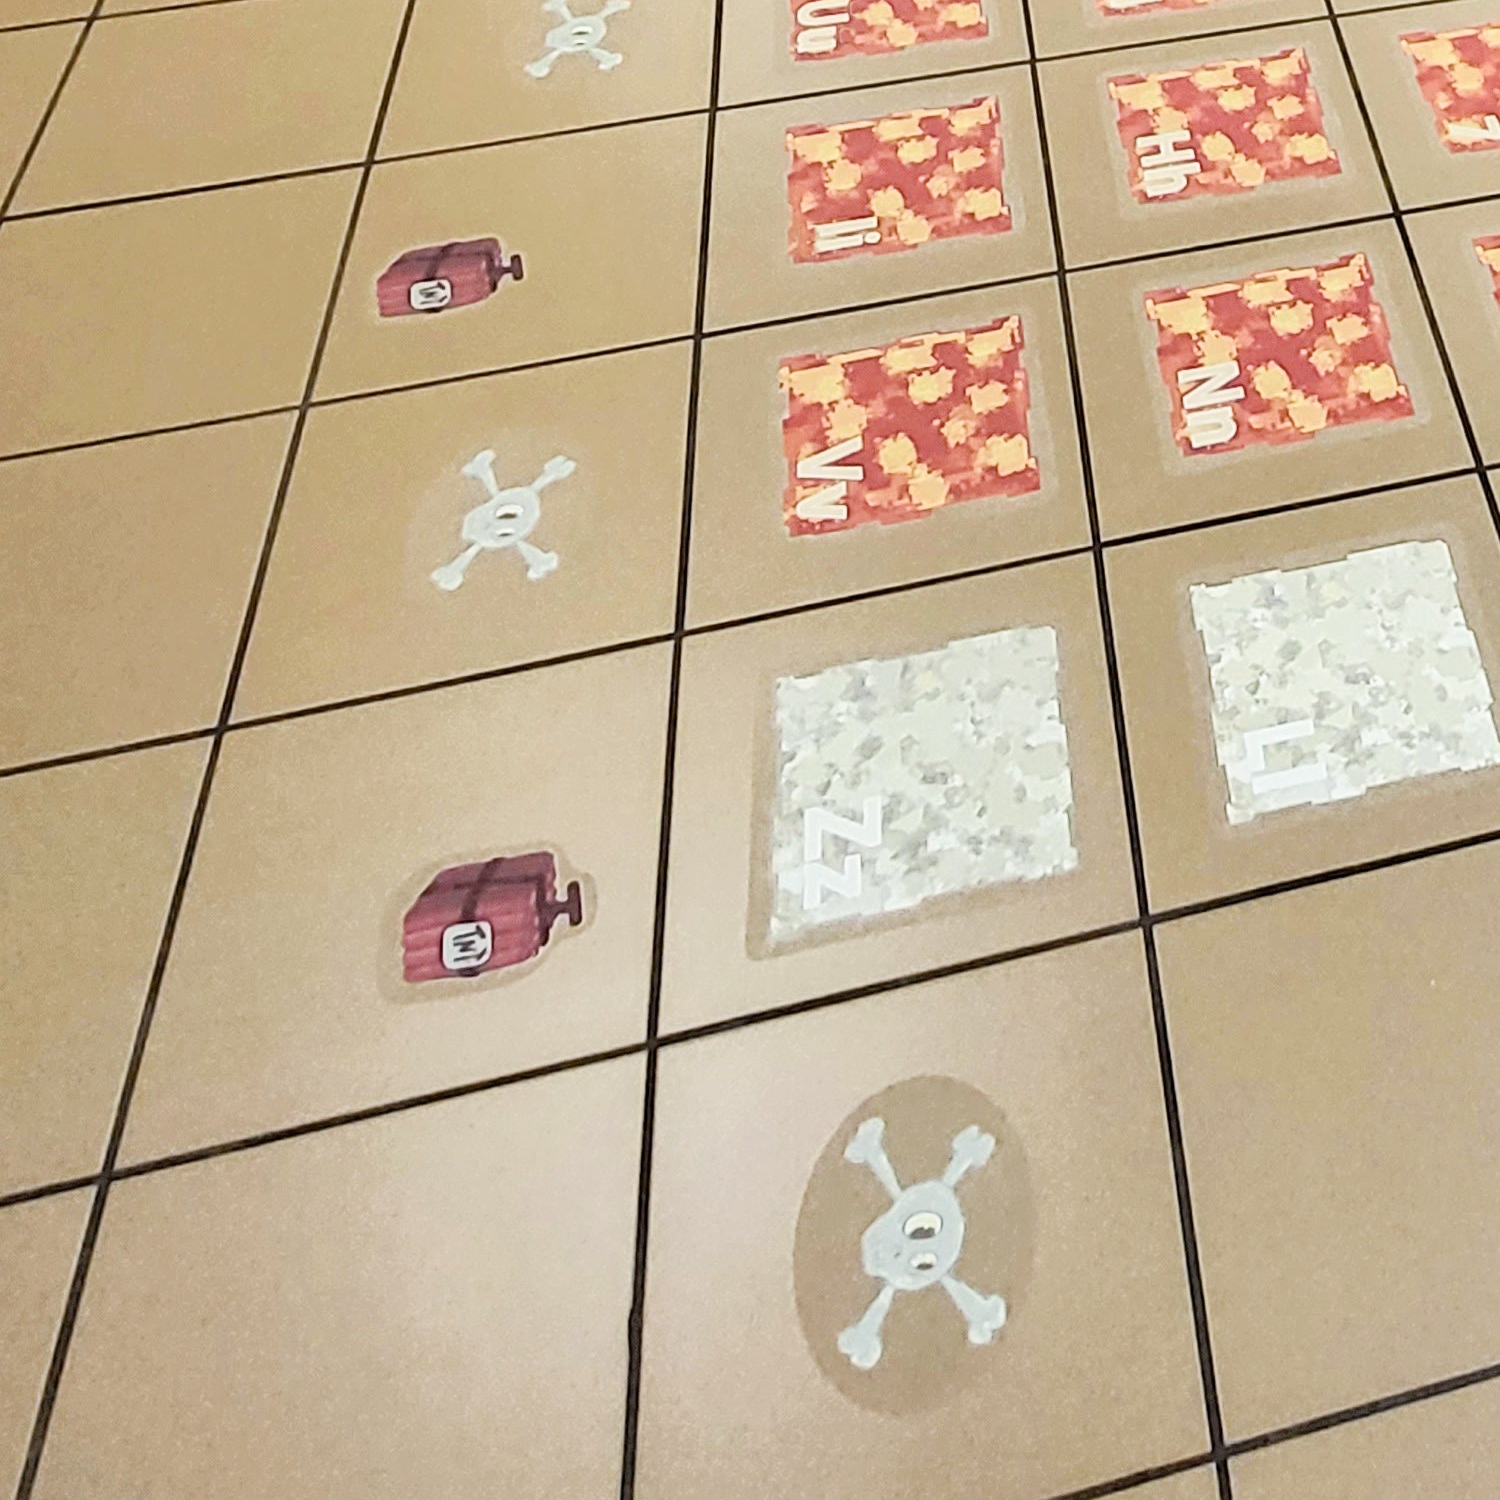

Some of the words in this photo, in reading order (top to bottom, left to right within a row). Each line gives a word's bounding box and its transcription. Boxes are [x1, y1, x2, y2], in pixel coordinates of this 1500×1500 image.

[1135, 130, 1201, 198] Hh
[813, 216, 881, 253] Ii
[1177, 360, 1245, 449] Nn
[796, 434, 864, 519] Vv
[1243, 718, 1326, 794] Ll
[803, 795, 881, 910] Zz
[453, 925, 487, 963] TNT
